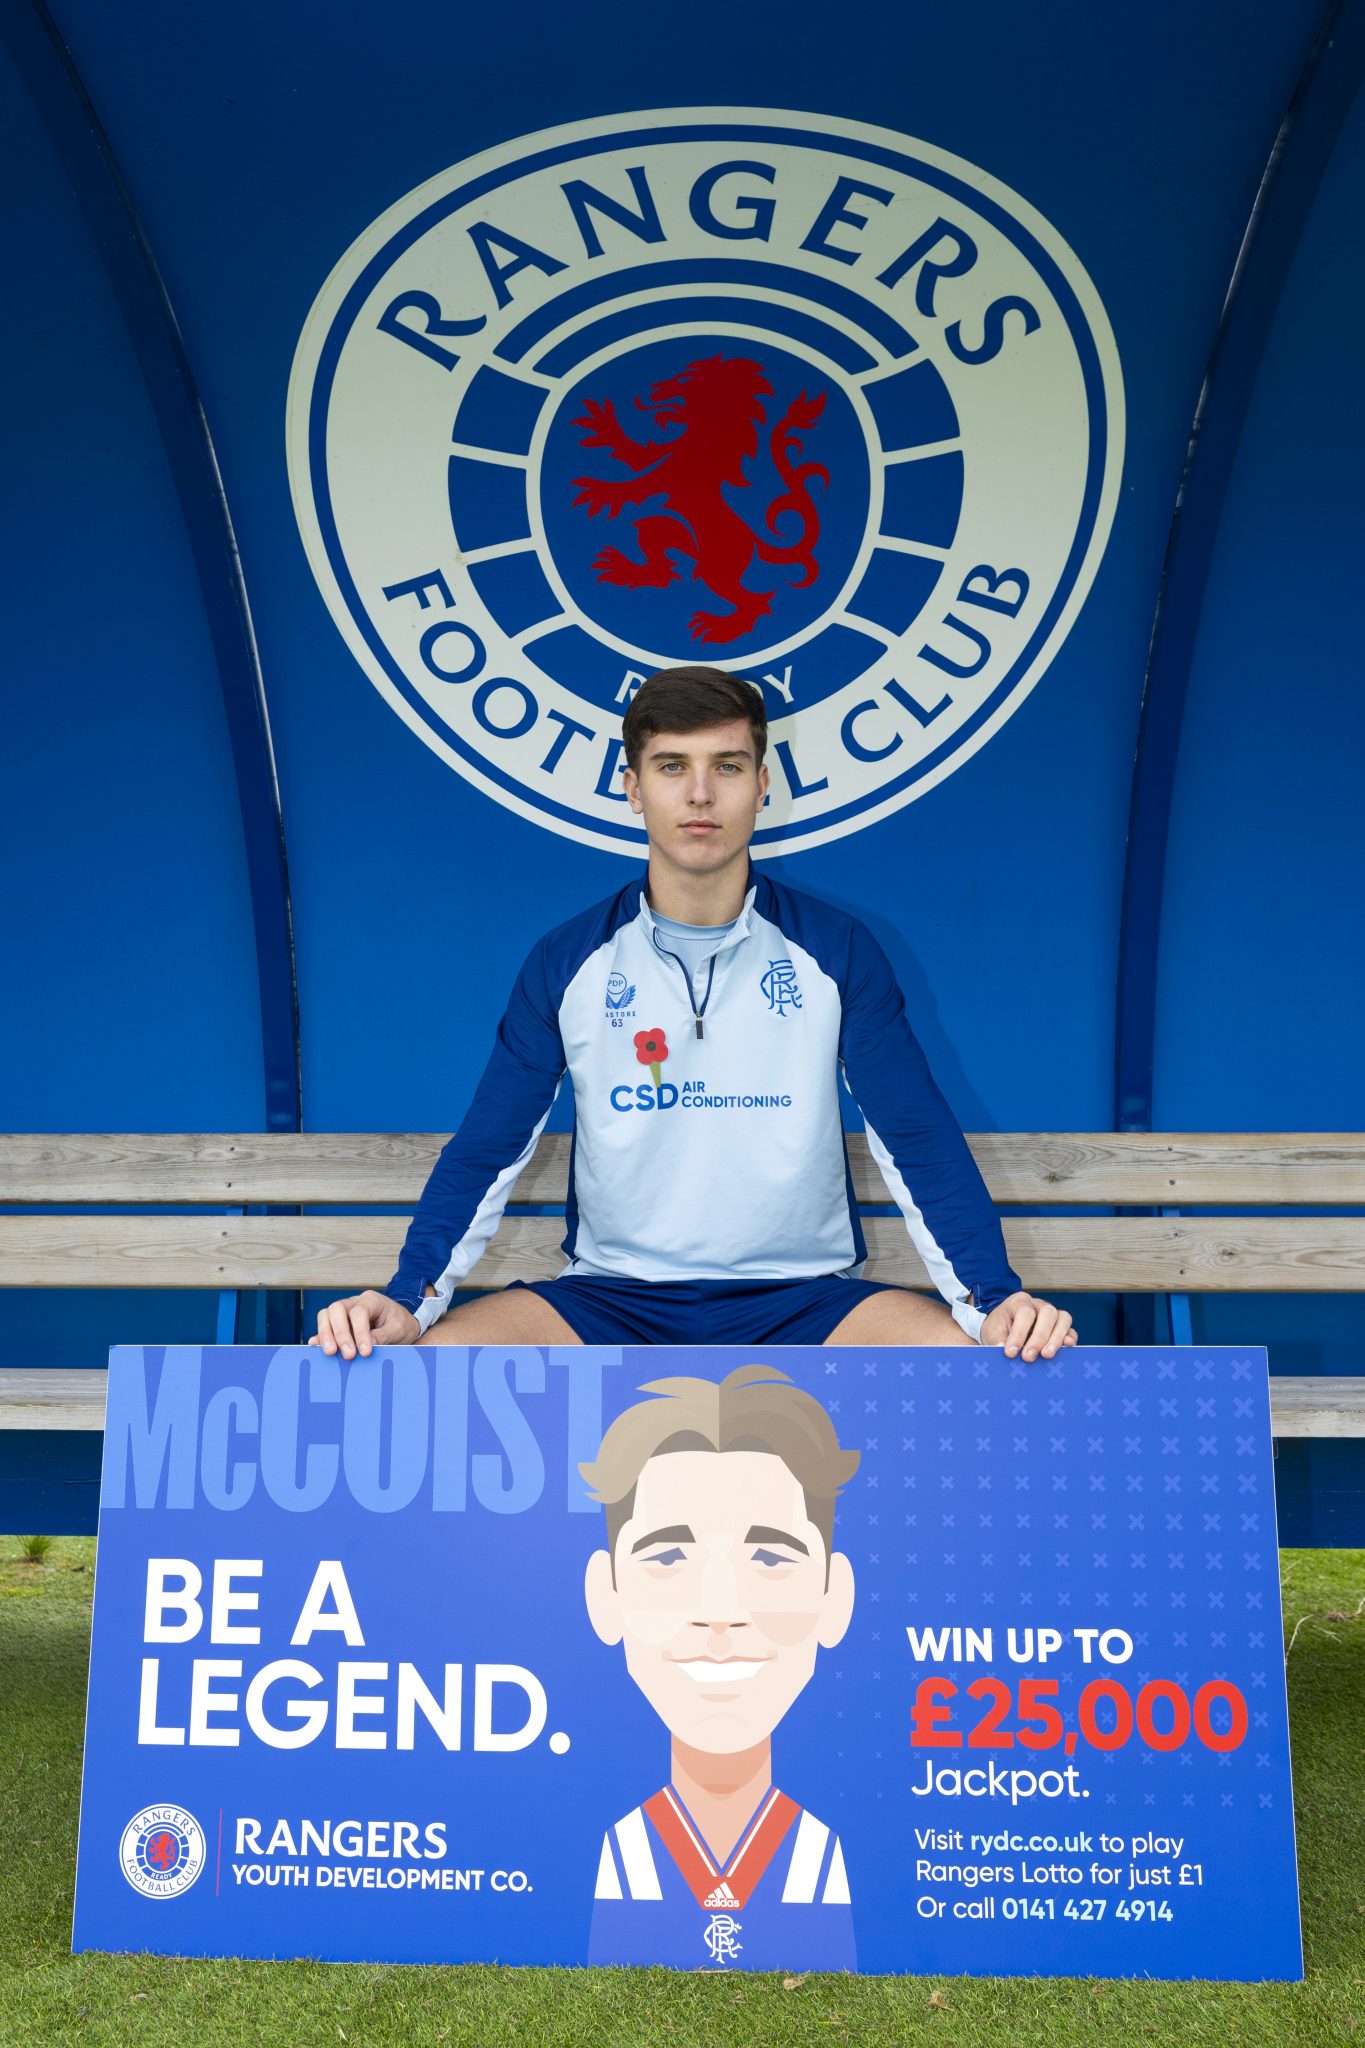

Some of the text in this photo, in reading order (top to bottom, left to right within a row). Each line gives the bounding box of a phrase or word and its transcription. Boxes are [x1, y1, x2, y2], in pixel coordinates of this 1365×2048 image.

[375, 159, 1042, 372] RANGERS
[839, 562, 1032, 764] CLUB
[605, 1010, 637, 1018] ASTORE
[611, 1018, 624, 1028] 63
[610, 1082, 679, 1113] CSD
[681, 1095, 792, 1108] CONDITIONING
[682, 1081, 706, 1093] AIR
[100, 1346, 622, 1514] McCOIST
[144, 1558, 366, 1647] BE A
[906, 1626, 1134, 1665] WIN UP TO
[137, 1658, 571, 1755] LEGEND.
[910, 1676, 1249, 1756] £25,000
[911, 1759, 1090, 1806] Jackpot.
[132, 1810, 196, 1837] RANGERS
[234, 1817, 448, 1859] RANGERS
[914, 1828, 1184, 1859] Visit rydc.co.uk to play
[126, 1859, 198, 1893] FOOTBALL CLUB
[150, 1872, 173, 1880] READY
[231, 1864, 533, 1892] YOUTH DEVELOPMENT CO.
[916, 1859, 1203, 1891] Rangers Lotto for just £1
[703, 1898, 740, 1908] adidas
[916, 1896, 1174, 1922] Or call 0141 427 4914
